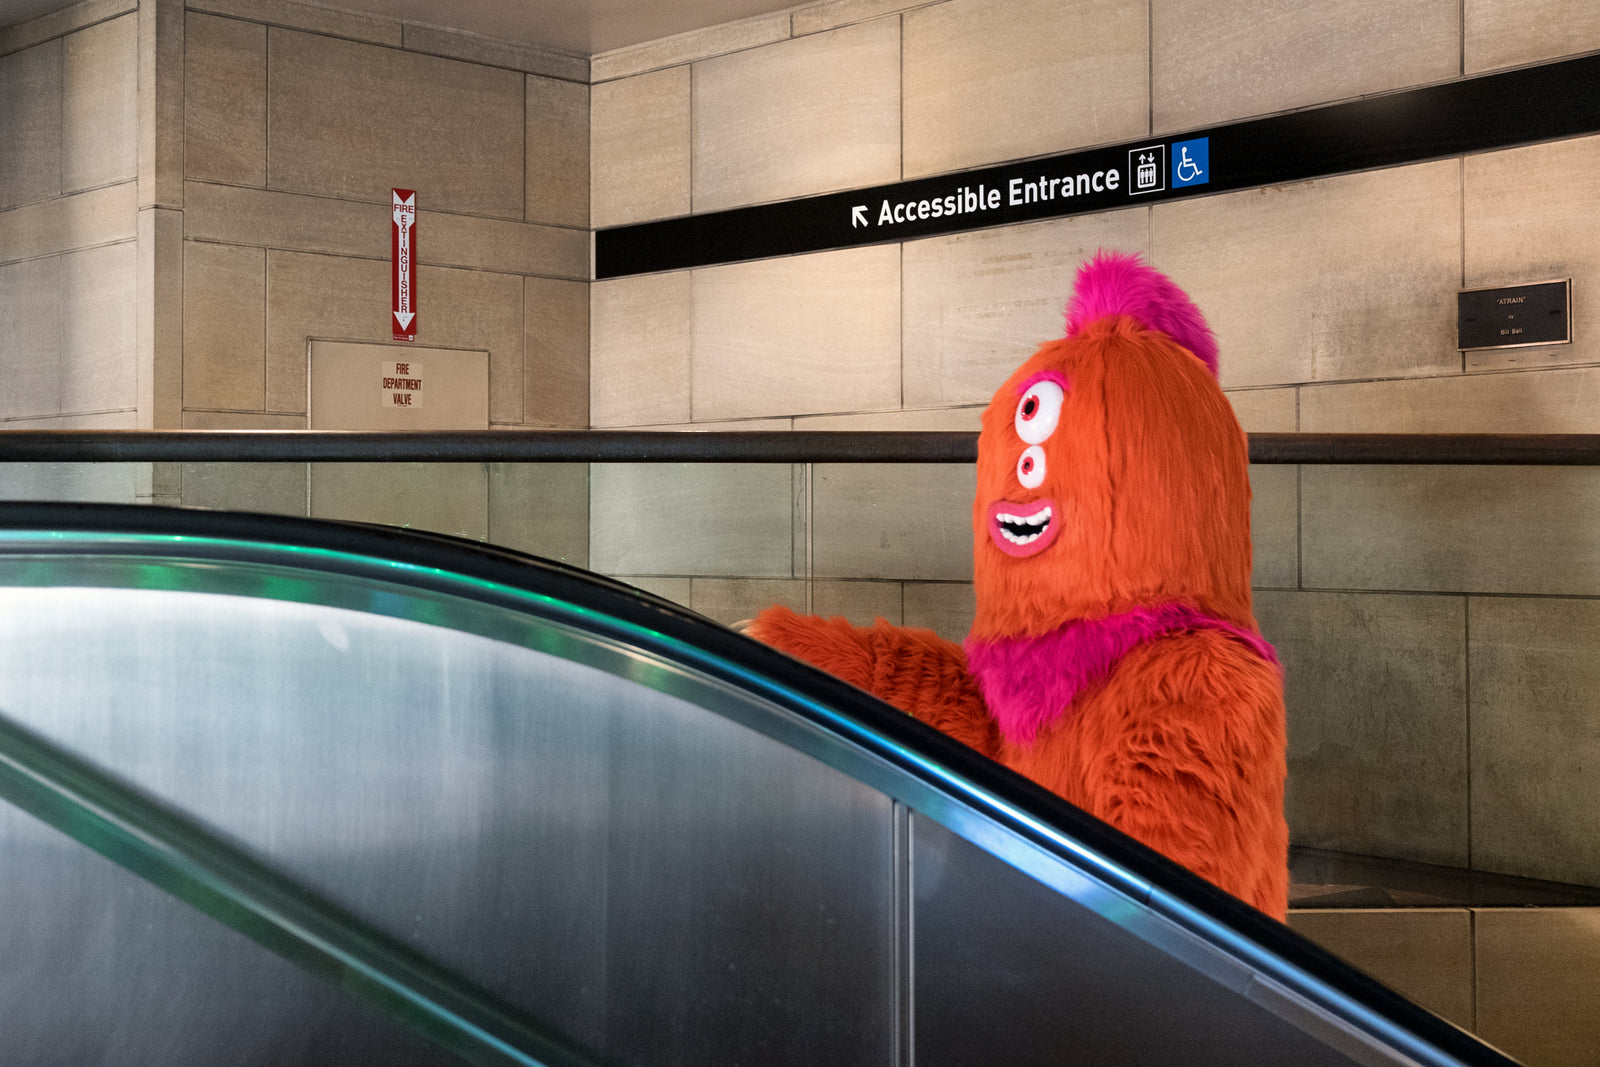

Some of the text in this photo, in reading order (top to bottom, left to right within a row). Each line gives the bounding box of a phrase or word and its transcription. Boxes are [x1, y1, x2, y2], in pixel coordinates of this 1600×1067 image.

[878, 168, 1120, 226] Accessible Entrance
[393, 203, 415, 214] FIRE
[400, 214, 408, 314] EXTINGUISHER
[395, 363, 410, 375] FIRE
[383, 377, 422, 391] DEPARTMENT
[393, 393, 412, 405] VALVE
